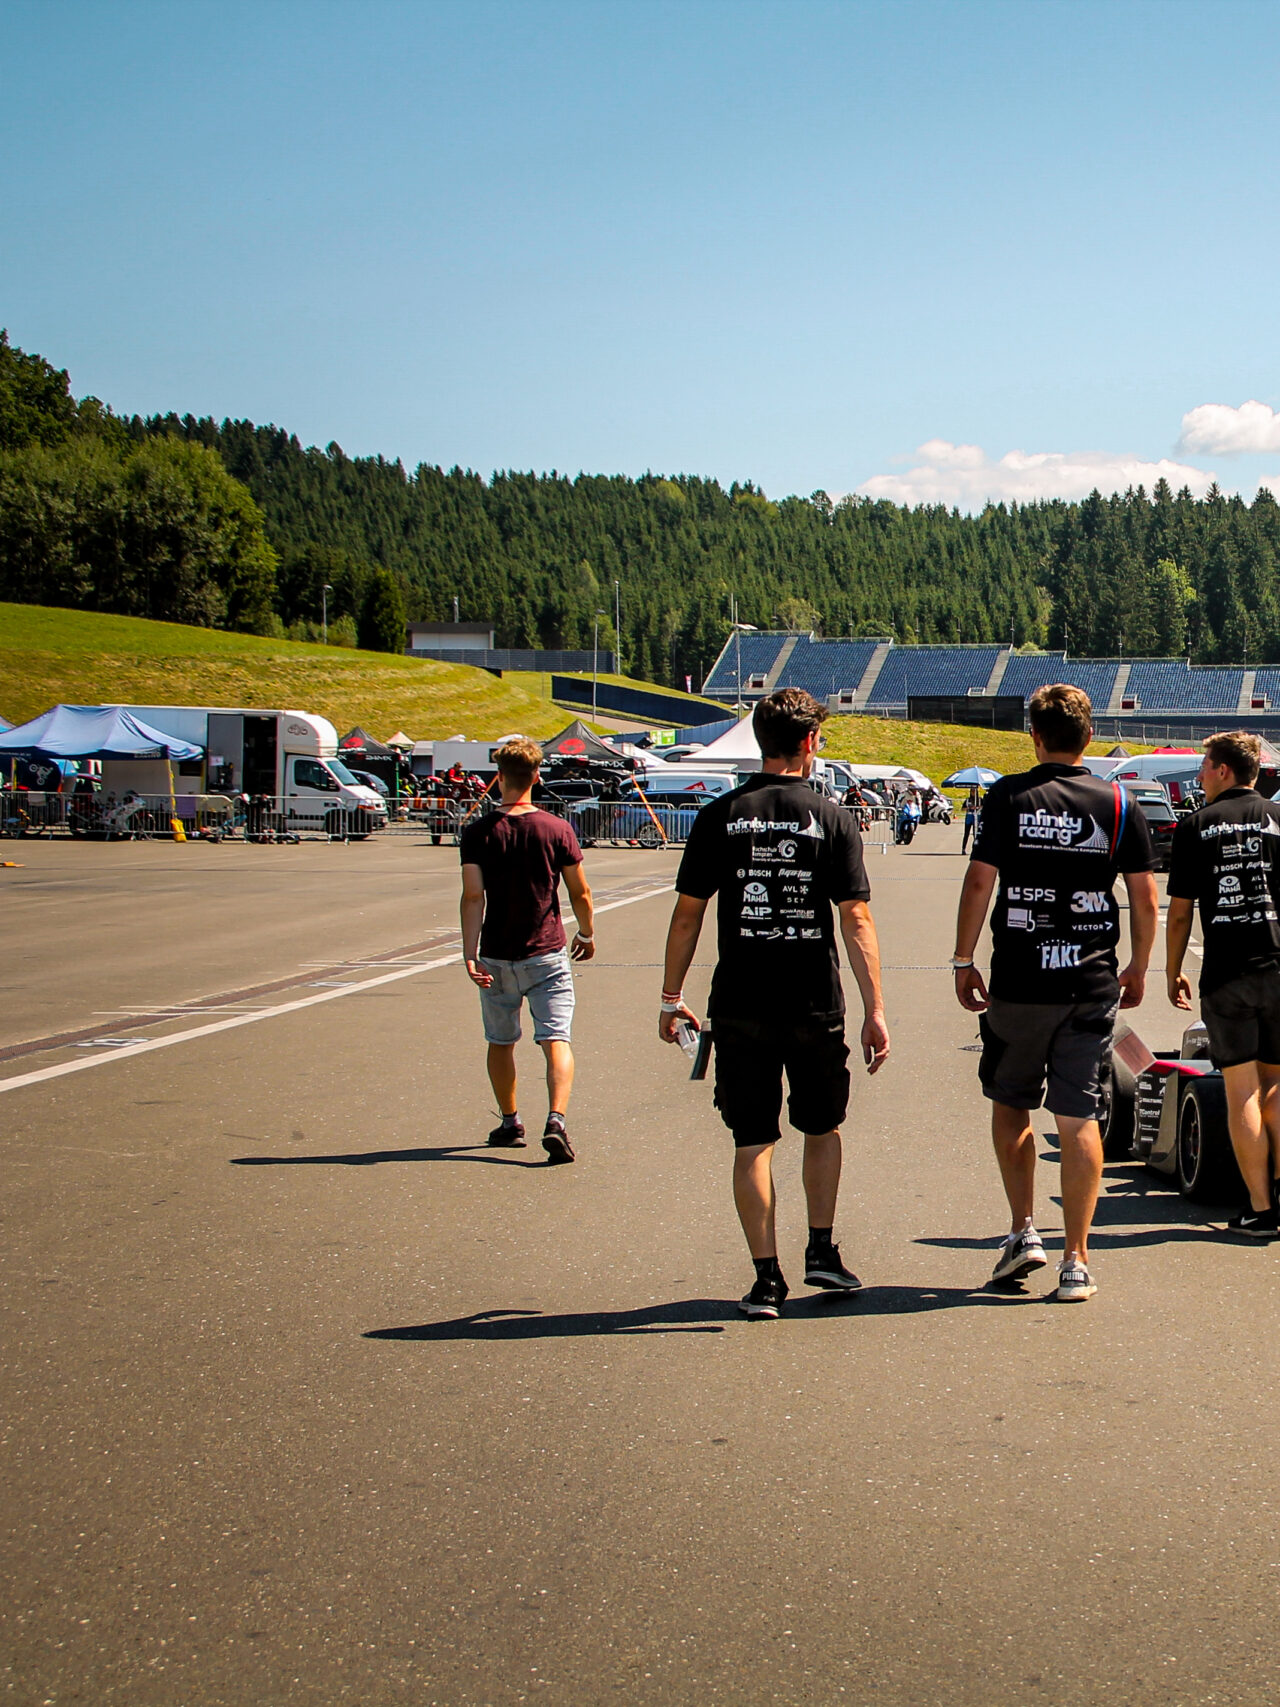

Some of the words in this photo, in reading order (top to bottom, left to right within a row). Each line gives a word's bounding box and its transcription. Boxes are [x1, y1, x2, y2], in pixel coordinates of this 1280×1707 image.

[726, 816, 767, 833] infinity
[767, 821, 799, 833] racing
[1018, 808, 1083, 834] infinity
[1018, 825, 1072, 846] racing
[1201, 821, 1234, 838] infinity
[748, 869, 772, 878] BOSCH
[1220, 862, 1243, 872] BOSCH
[782, 885, 798, 893] AVL
[1219, 882, 1241, 894] MAHA
[743, 890, 769, 903] MAHA
[1023, 888, 1056, 902] SPS
[1217, 895, 1245, 905] AIP
[1070, 891, 1110, 913] 3M
[740, 906, 772, 916] AIP
[1072, 923, 1104, 931] VECTOR
[1041, 944, 1082, 969] FAKT
